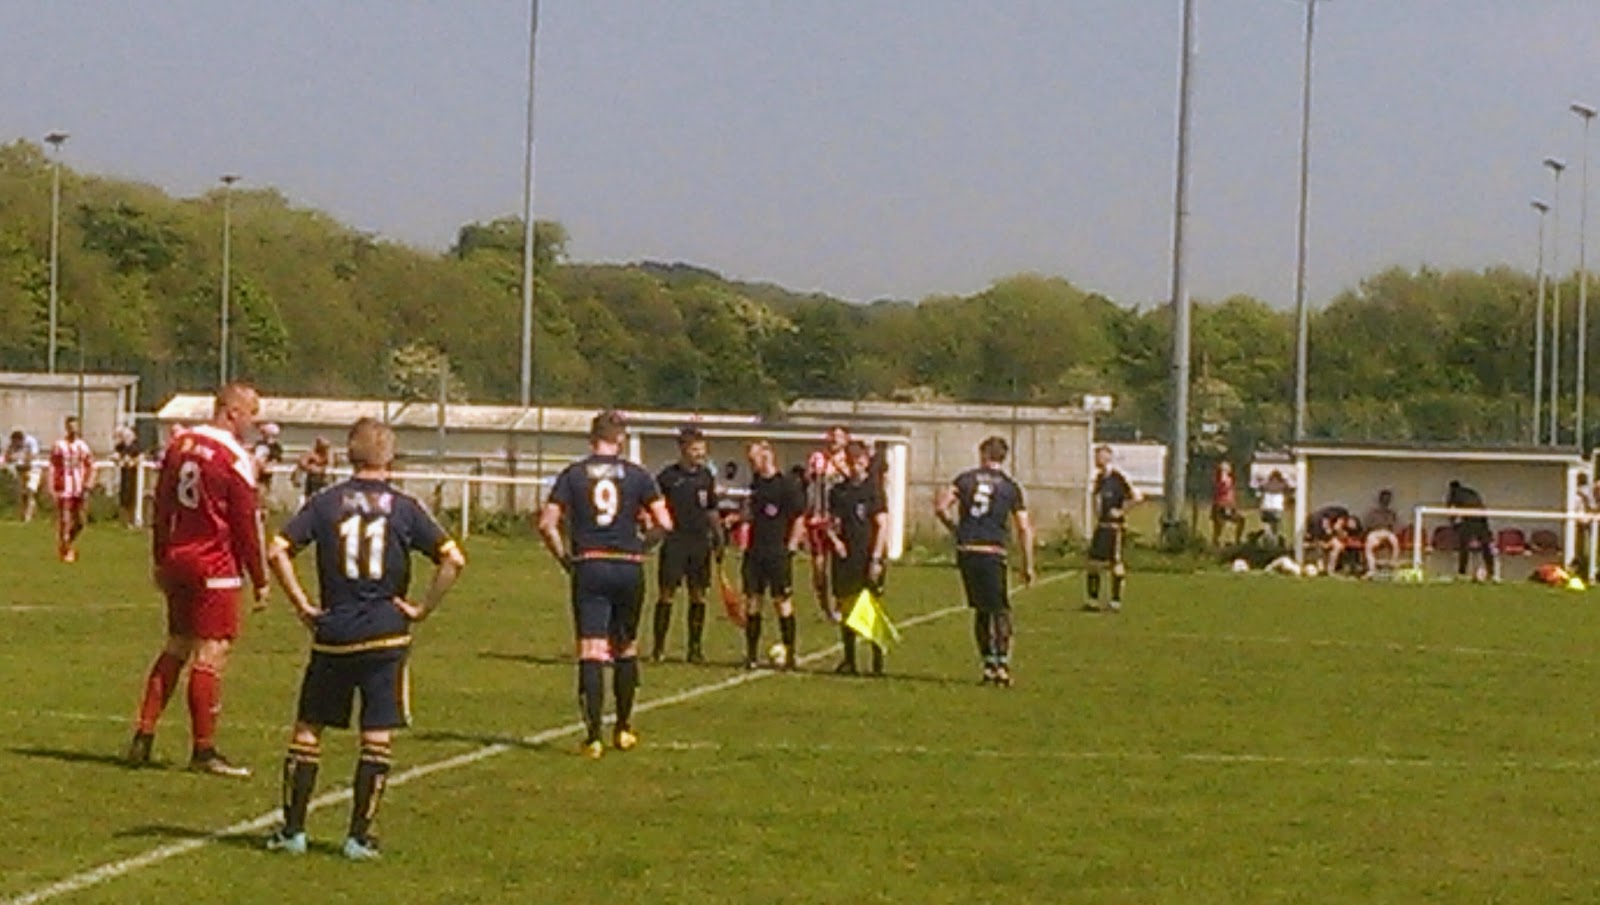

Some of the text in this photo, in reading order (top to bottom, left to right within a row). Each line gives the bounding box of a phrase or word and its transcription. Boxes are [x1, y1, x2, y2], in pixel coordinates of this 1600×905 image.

[178, 461, 200, 509] 8
[594, 480, 617, 526] 9
[970, 484, 993, 517] 5
[340, 514, 387, 579] 11
